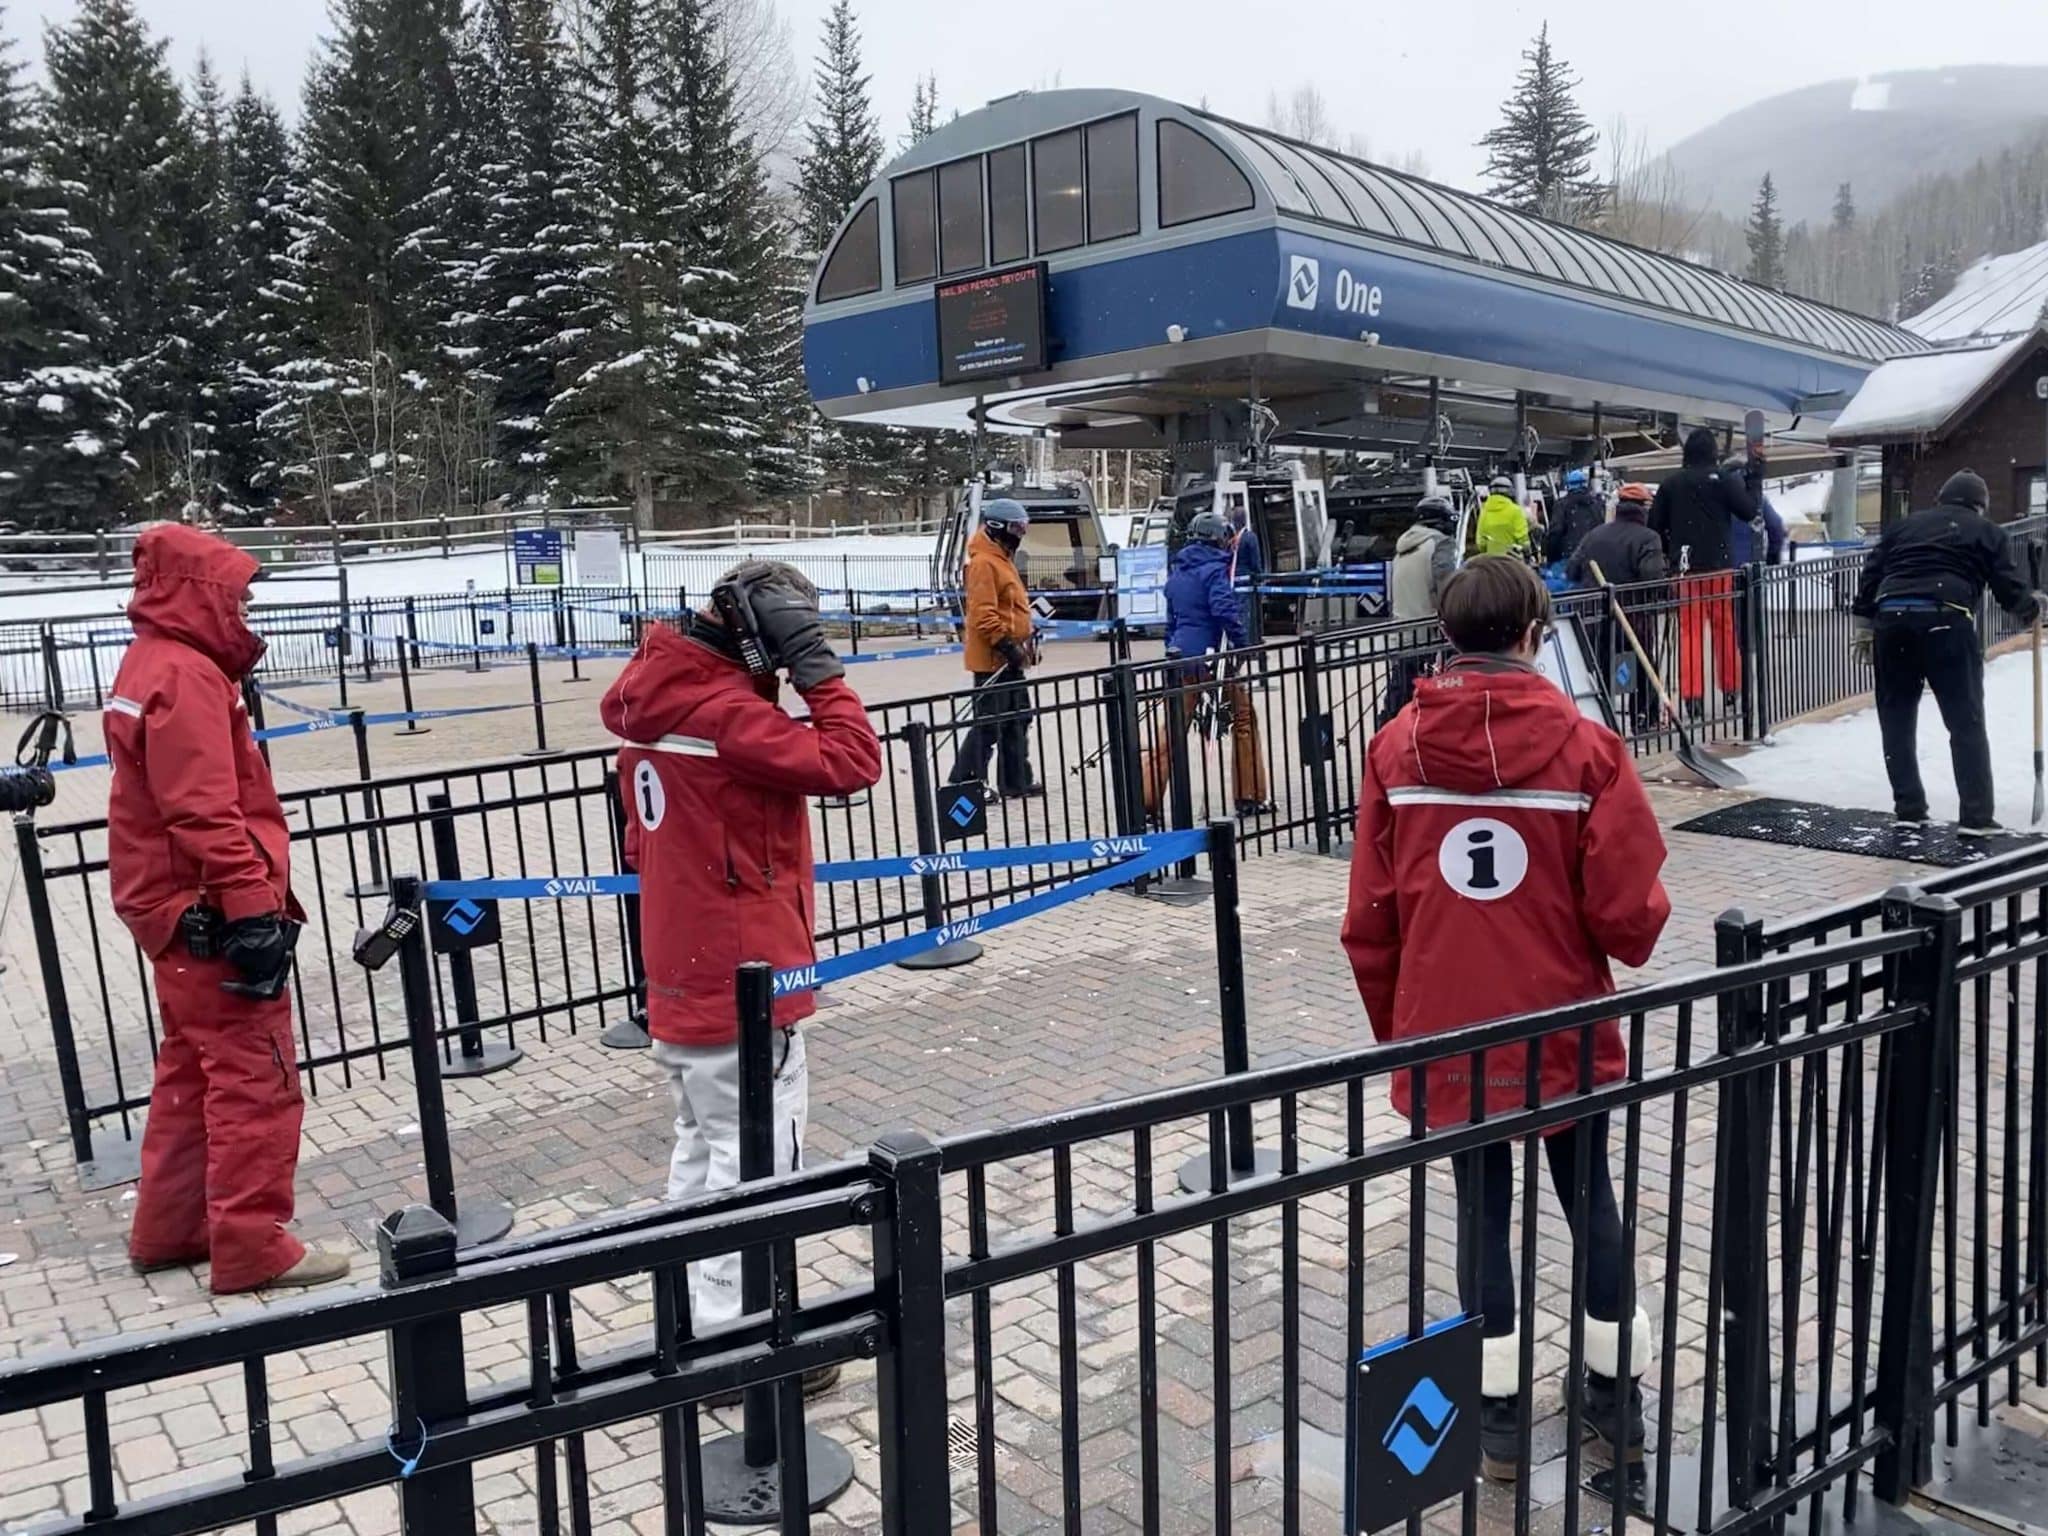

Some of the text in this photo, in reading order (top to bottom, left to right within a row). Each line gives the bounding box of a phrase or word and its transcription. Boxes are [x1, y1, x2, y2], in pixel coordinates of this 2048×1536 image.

[1336, 268, 1382, 317] One
[1108, 838, 1149, 854] VAIL
[927, 856, 968, 871] VAIL
[1467, 829, 1499, 889] i
[562, 879, 605, 894] VAIL
[951, 918, 984, 940] VAIL
[782, 965, 824, 991] VAIL
